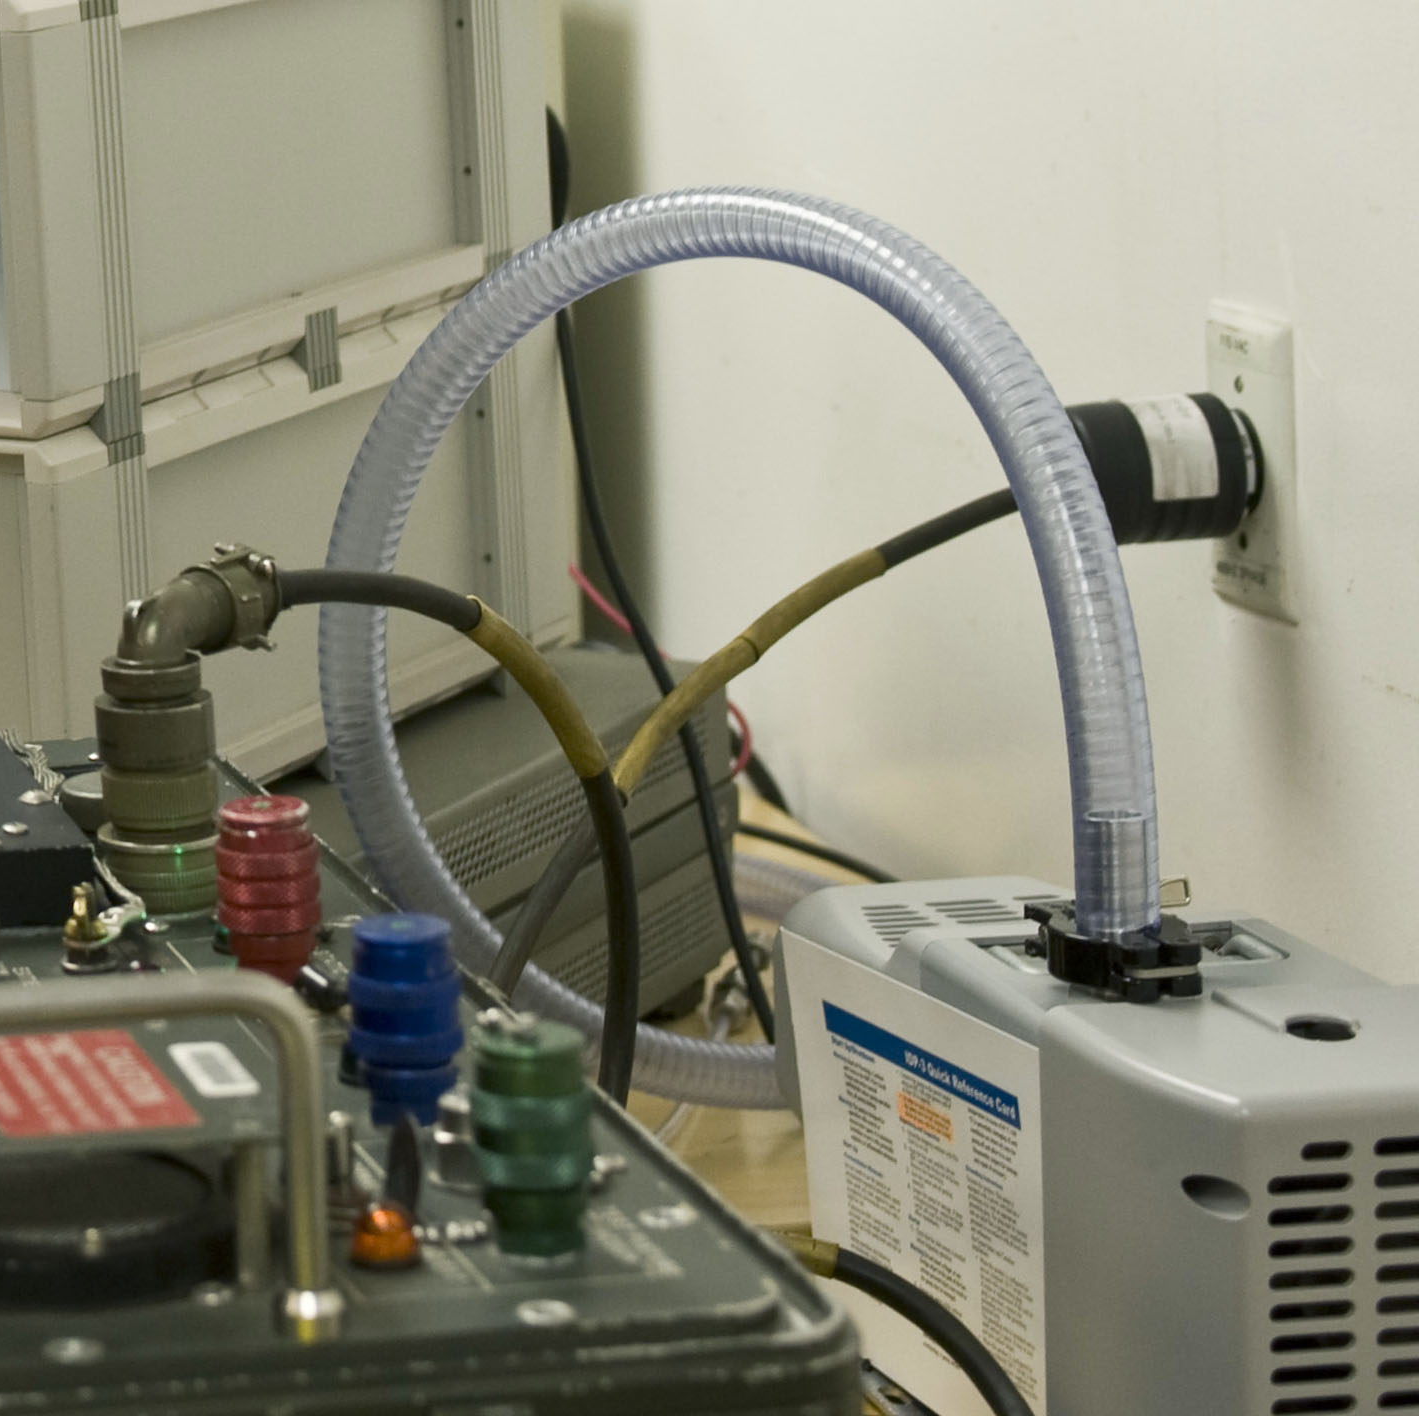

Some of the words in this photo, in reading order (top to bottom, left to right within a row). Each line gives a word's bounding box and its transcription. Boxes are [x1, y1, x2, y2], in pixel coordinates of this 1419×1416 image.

[927, 1060, 951, 1085] Quick
[952, 1074, 995, 1107] Reference
[995, 1098, 1016, 1120] Card
